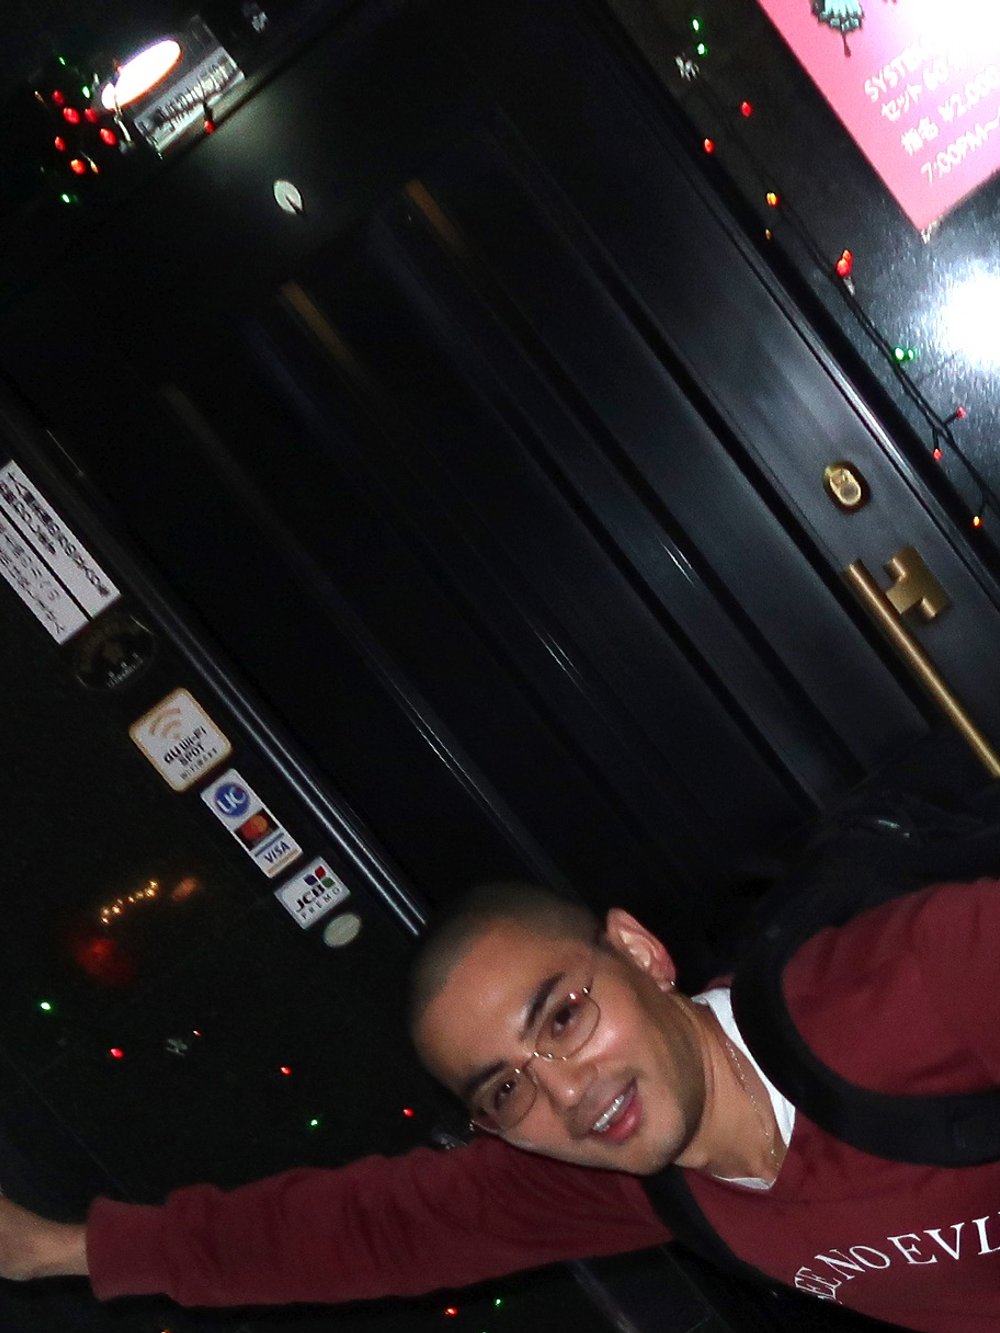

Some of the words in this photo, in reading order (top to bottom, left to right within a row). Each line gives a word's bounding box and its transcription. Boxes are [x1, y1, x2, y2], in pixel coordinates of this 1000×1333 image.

[180, 742, 205, 766] SPOT
[264, 841, 291, 864] VISA
[296, 884, 325, 912] JCB
[814, 1246, 891, 1280] NO
[794, 1266, 843, 1304] EE
